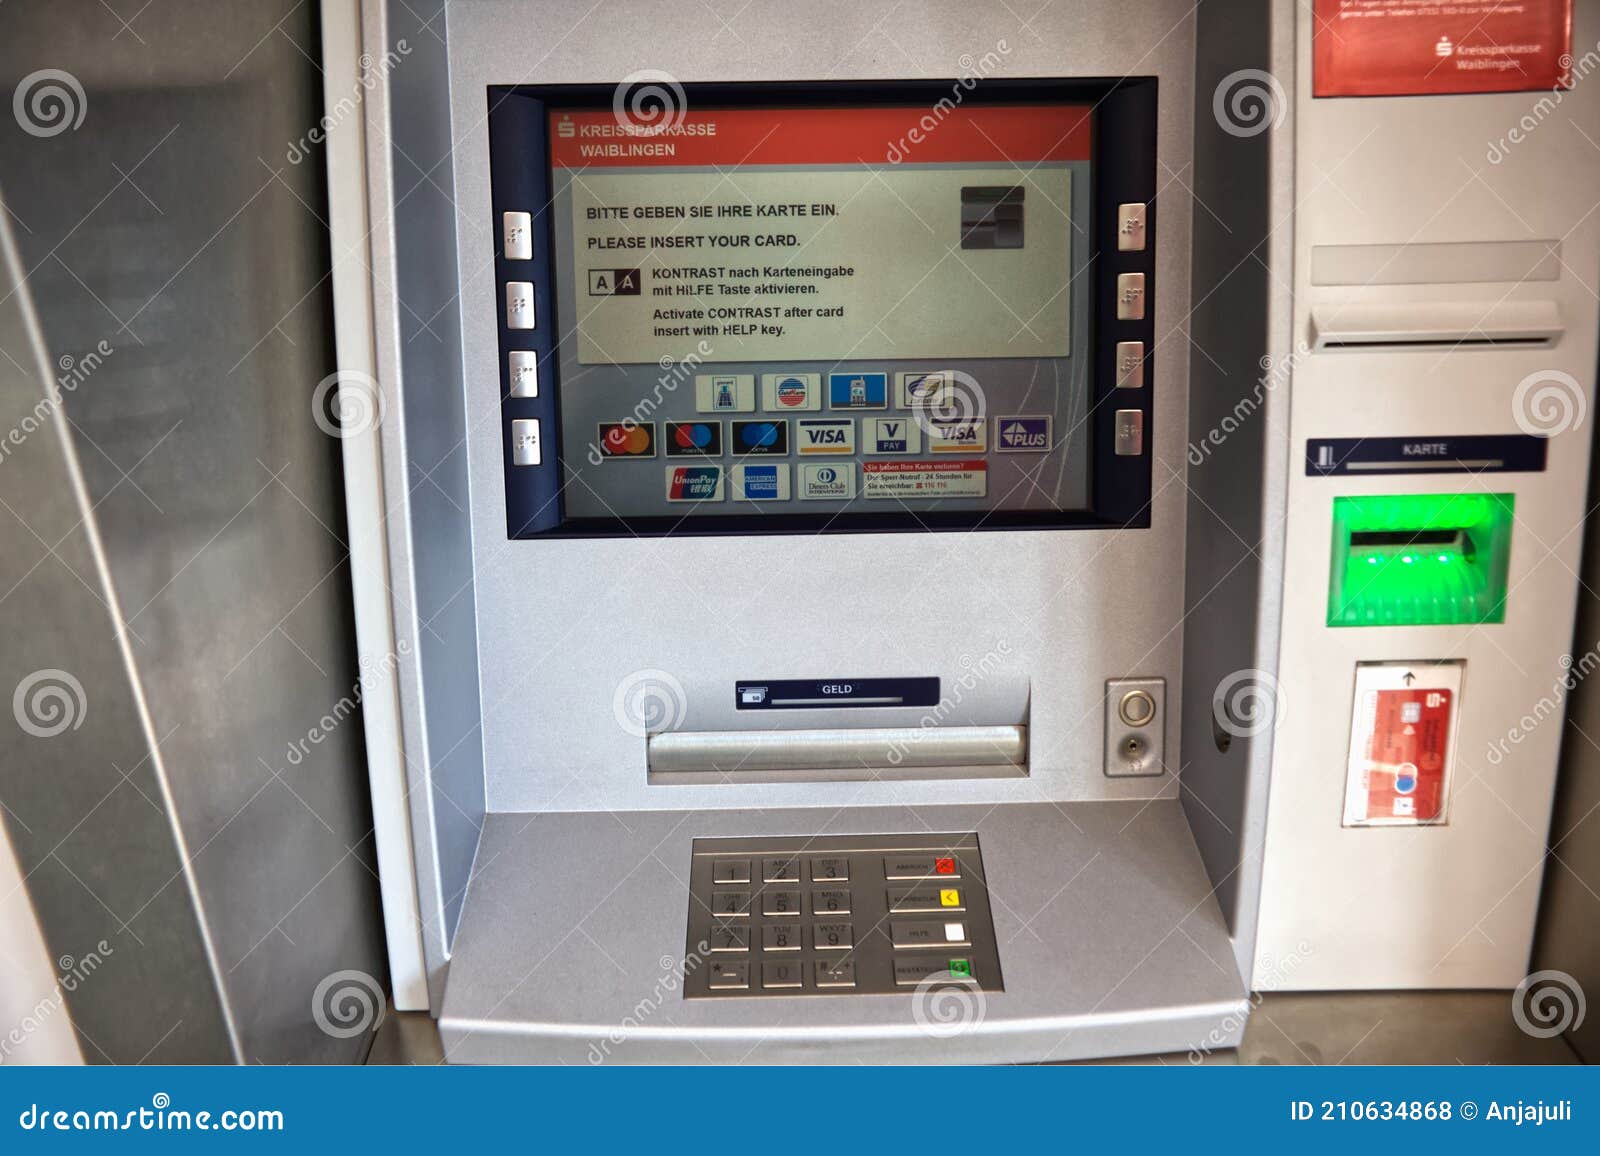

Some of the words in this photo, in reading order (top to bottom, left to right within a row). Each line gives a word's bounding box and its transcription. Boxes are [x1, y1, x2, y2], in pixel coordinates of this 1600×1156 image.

[1457, 44, 1541, 56] Kreissparkasse
[1457, 59, 1521, 71] Waiblingen
[580, 124, 717, 137] KREISSPARKASSE
[580, 144, 676, 157] WAIBLINGEN
[587, 207, 629, 219] BITTE
[634, 206, 685, 218] GEBEN
[690, 206, 713, 218] SIE
[718, 205, 752, 217] IHRE
[757, 205, 807, 217] KARTE
[812, 204, 839, 216] EIN.
[588, 237, 646, 249] PLEASE
[651, 236, 704, 248] INSERT
[708, 235, 750, 247] YOUR
[755, 235, 800, 247] CARD.
[652, 268, 725, 279] KONTRAST
[729, 267, 759, 278] nach
[763, 266, 854, 279] Karteneingabe
[653, 285, 672, 296] mit
[720, 284, 751, 295] Taste
[754, 283, 819, 295] aktivieren.
[653, 308, 704, 320] Activate
[708, 307, 781, 319] CONTRAST
[784, 307, 812, 318] after
[816, 306, 844, 317] card
[654, 325, 690, 337] insert
[692, 324, 719, 336] with
[723, 324, 757, 335] HELP
[761, 324, 786, 337] key.
[806, 430, 846, 443] VISA
[884, 423, 899, 438] V
[941, 426, 976, 440] VISA
[1013, 433, 1046, 446] PLUS
[1403, 443, 1448, 455] KARTE
[674, 475, 716, 484] UnionPay
[822, 685, 852, 694] GELD
[729, 868, 735, 880] 1
[777, 867, 787, 879] 2
[826, 867, 836, 878] 3
[726, 901, 736, 913] 4
[777, 900, 787, 912] 5
[827, 899, 838, 911] 6
[725, 935, 734, 948] 7
[777, 934, 787, 947] 8
[828, 933, 839, 946] 9
[777, 966, 788, 979] 0
